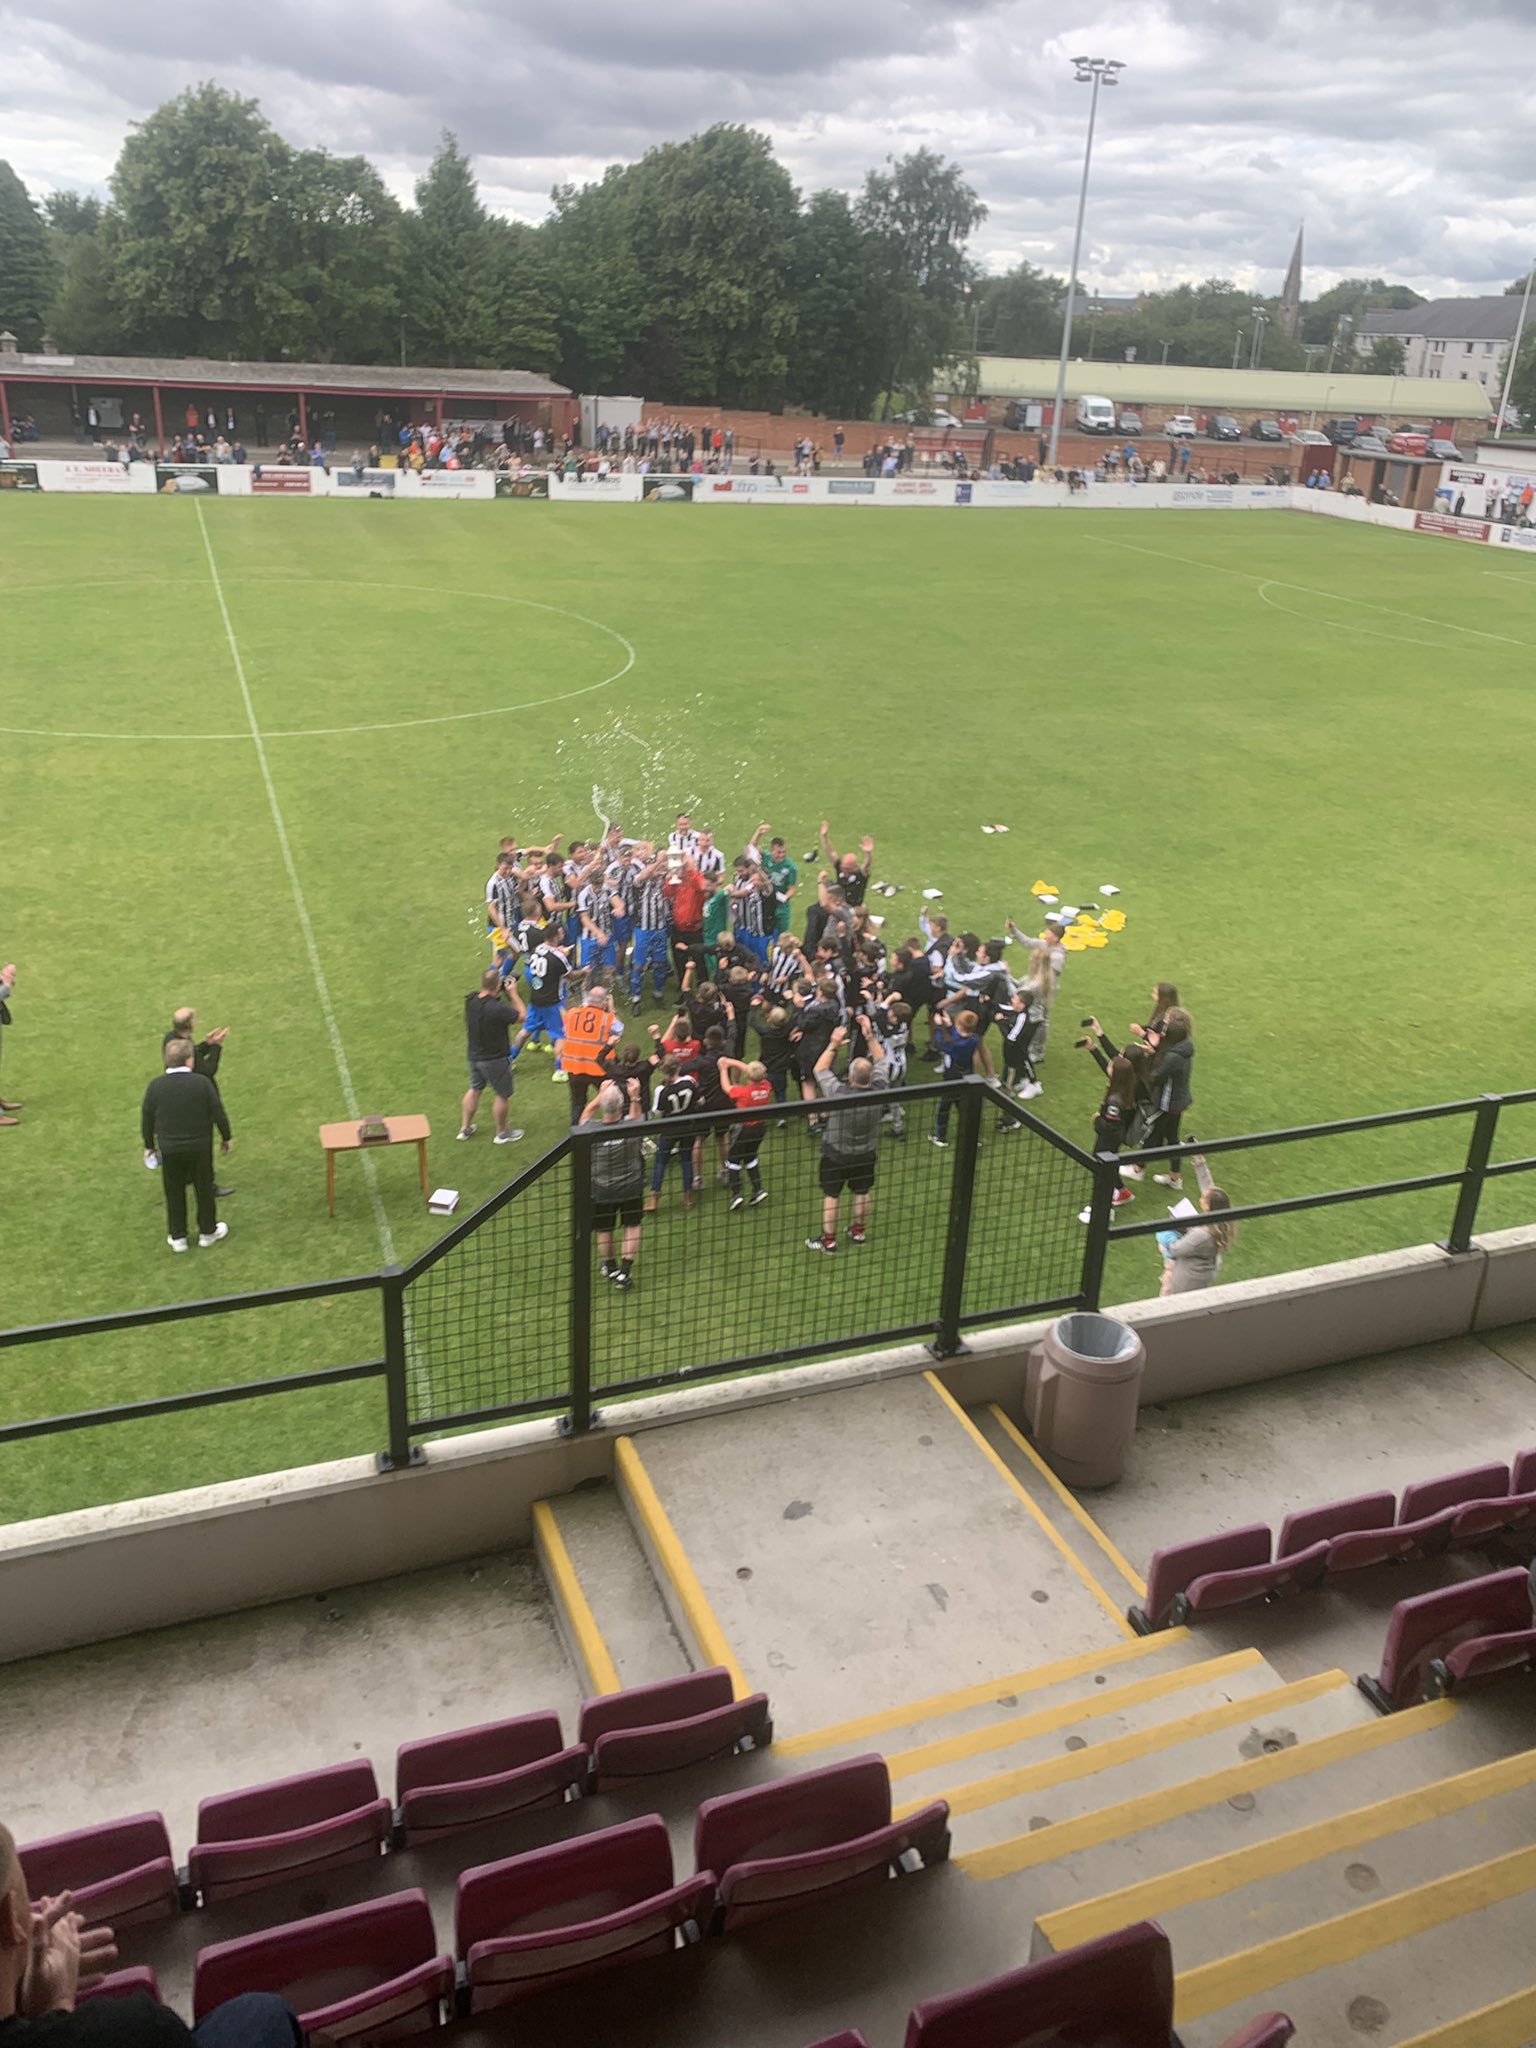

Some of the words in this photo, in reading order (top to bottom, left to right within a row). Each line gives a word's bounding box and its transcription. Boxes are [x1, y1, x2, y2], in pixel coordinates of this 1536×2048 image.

[530, 953, 548, 978] 20
[574, 1011, 596, 1034] 18
[668, 1088, 693, 1114] 17
